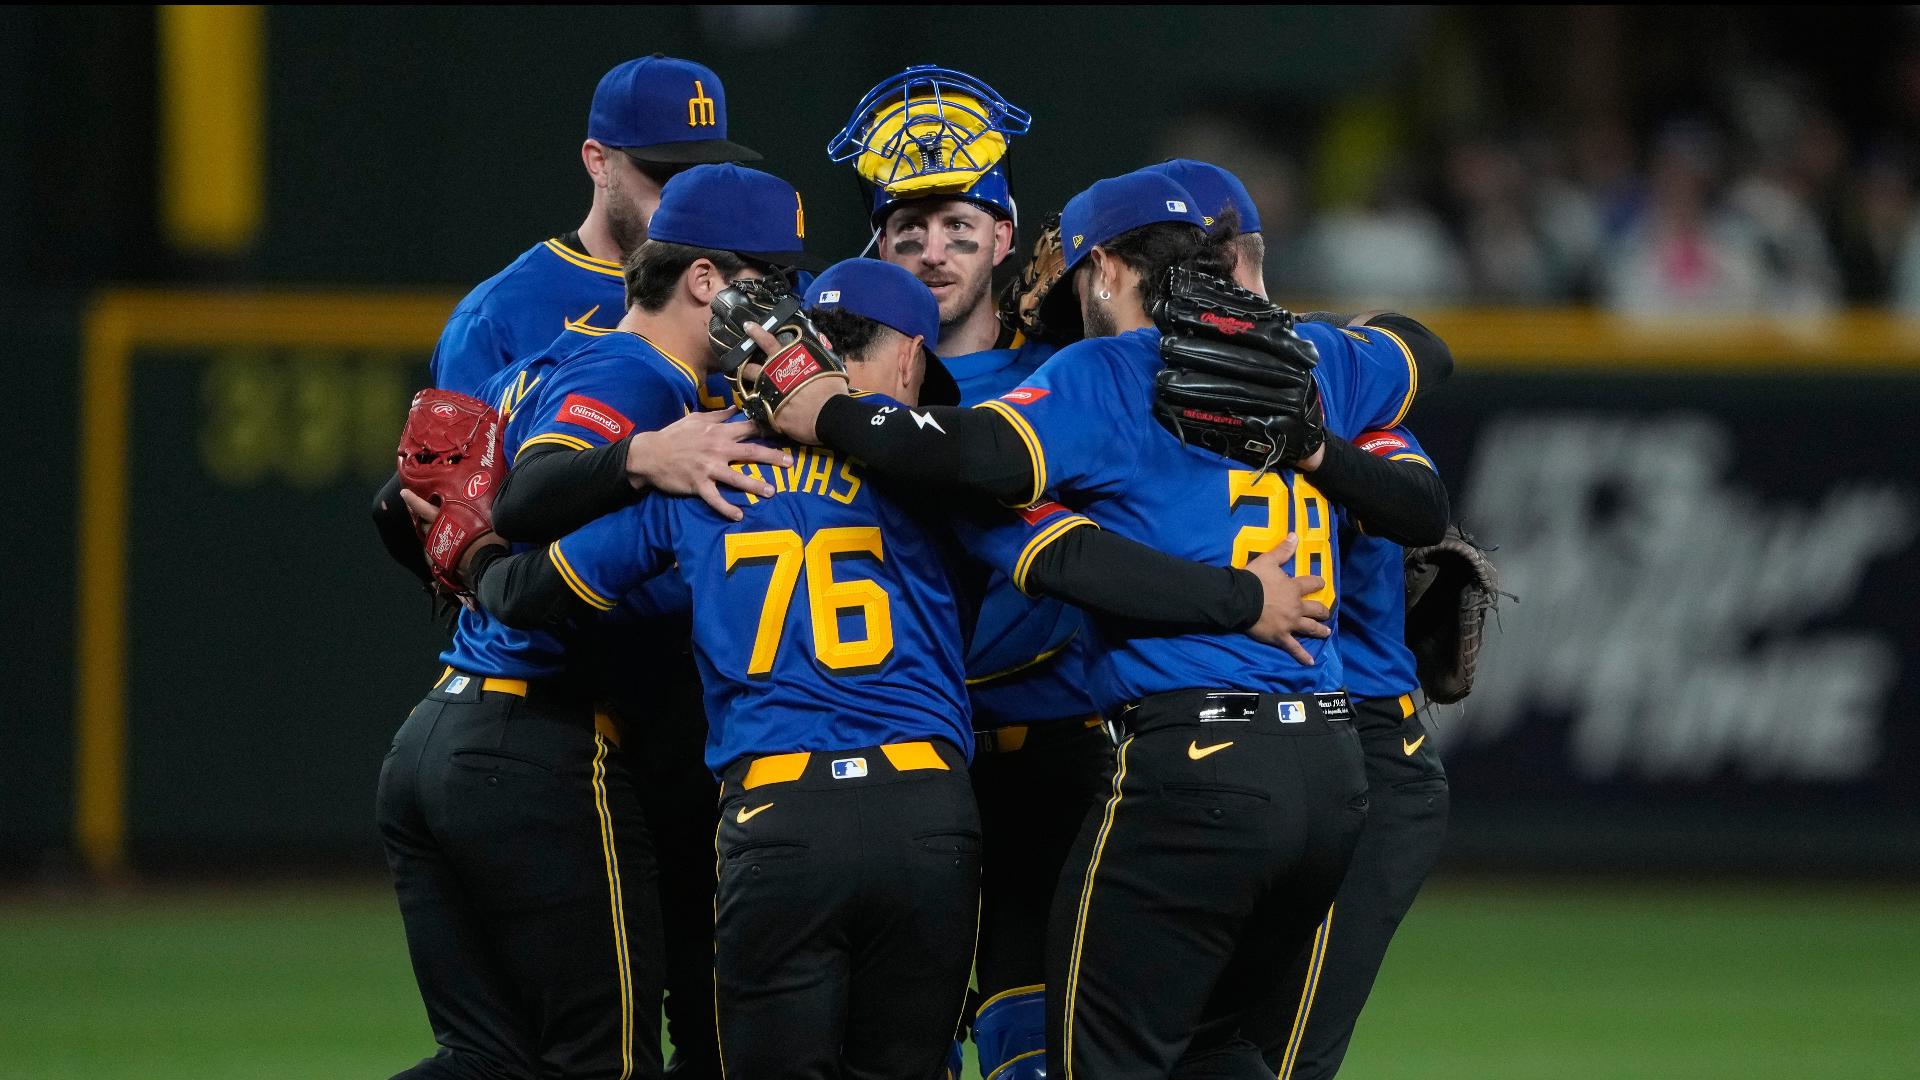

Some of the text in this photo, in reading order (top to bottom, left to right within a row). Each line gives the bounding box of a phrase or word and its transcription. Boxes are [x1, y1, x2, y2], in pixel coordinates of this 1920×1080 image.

[776, 353, 806, 383] Rawlings
[574, 406, 618, 430] Nintendo
[1361, 439, 1404, 451] Nintendo
[434, 523, 453, 560] Rawlings
[1228, 469, 1337, 610] 28
[725, 526, 895, 681] 76
